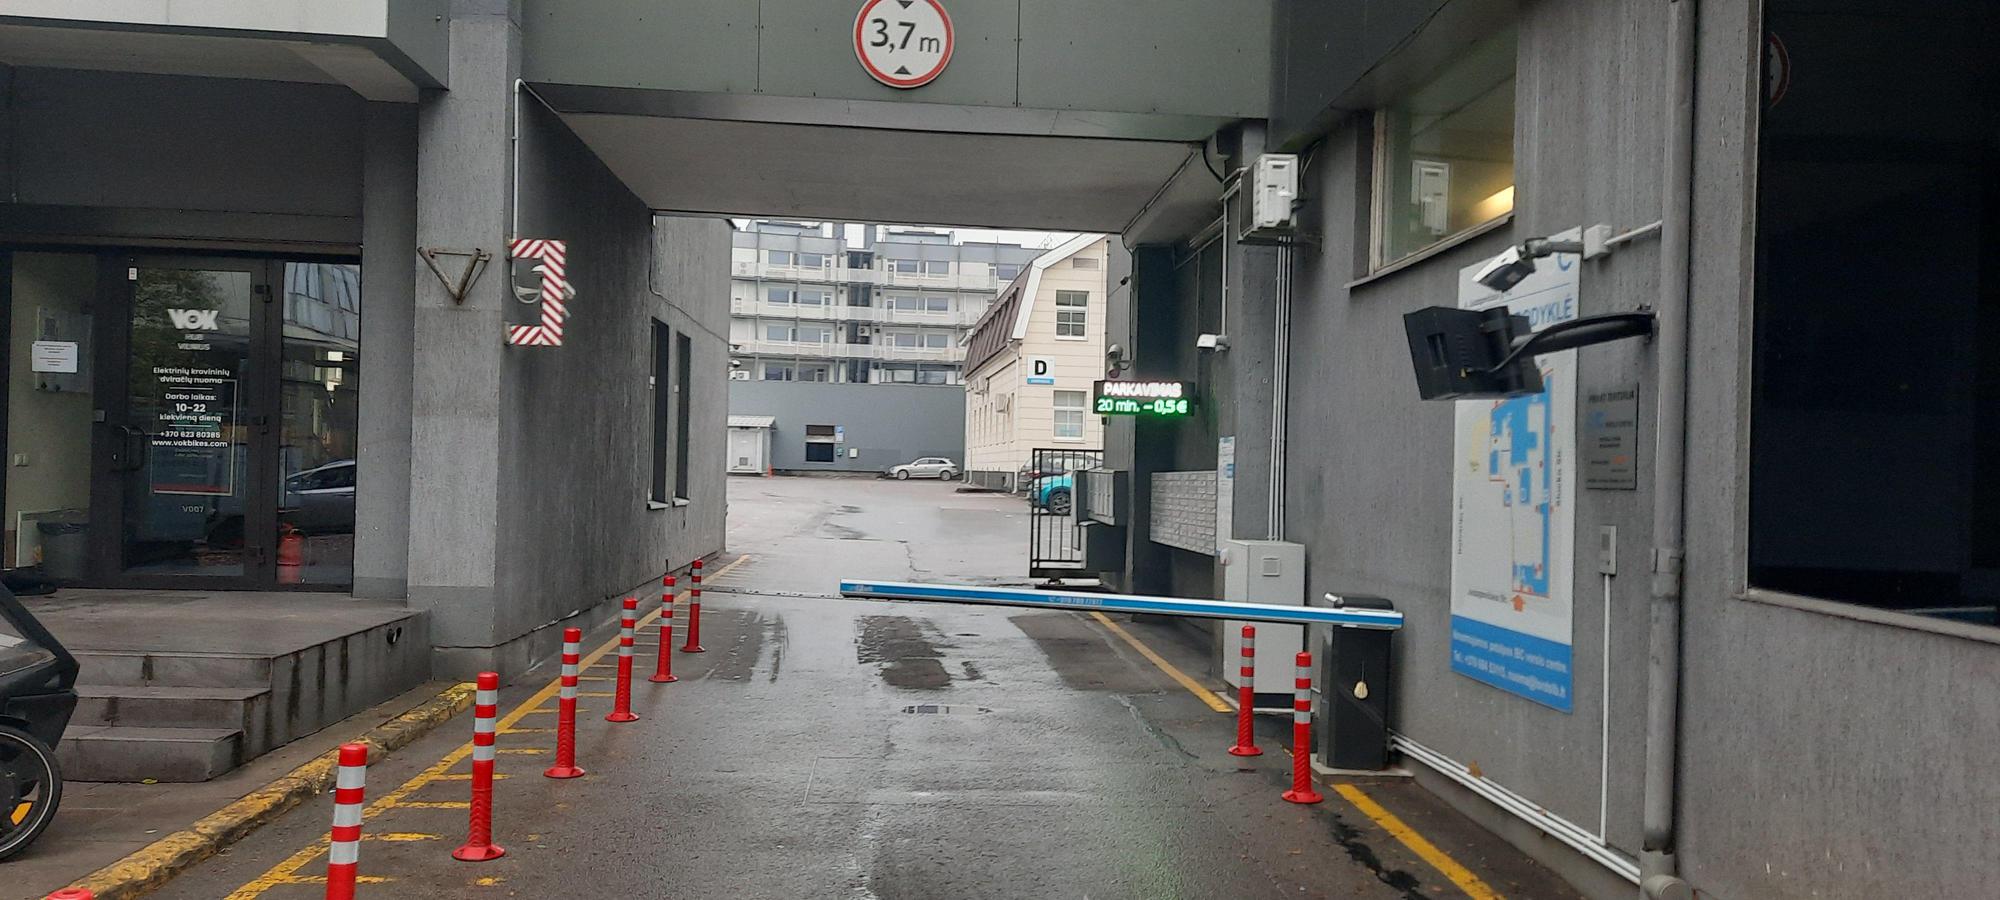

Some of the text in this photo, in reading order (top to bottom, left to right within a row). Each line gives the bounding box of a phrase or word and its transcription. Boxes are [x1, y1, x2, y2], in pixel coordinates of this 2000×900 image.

[870, 18, 940, 53] 3,7 m
[167, 309, 219, 330] VOK
[153, 367, 190, 376] Elektrinių
[1034, 360, 1047, 375] D
[1097, 399, 1114, 411] 20
[1115, 400, 1140, 412] min.
